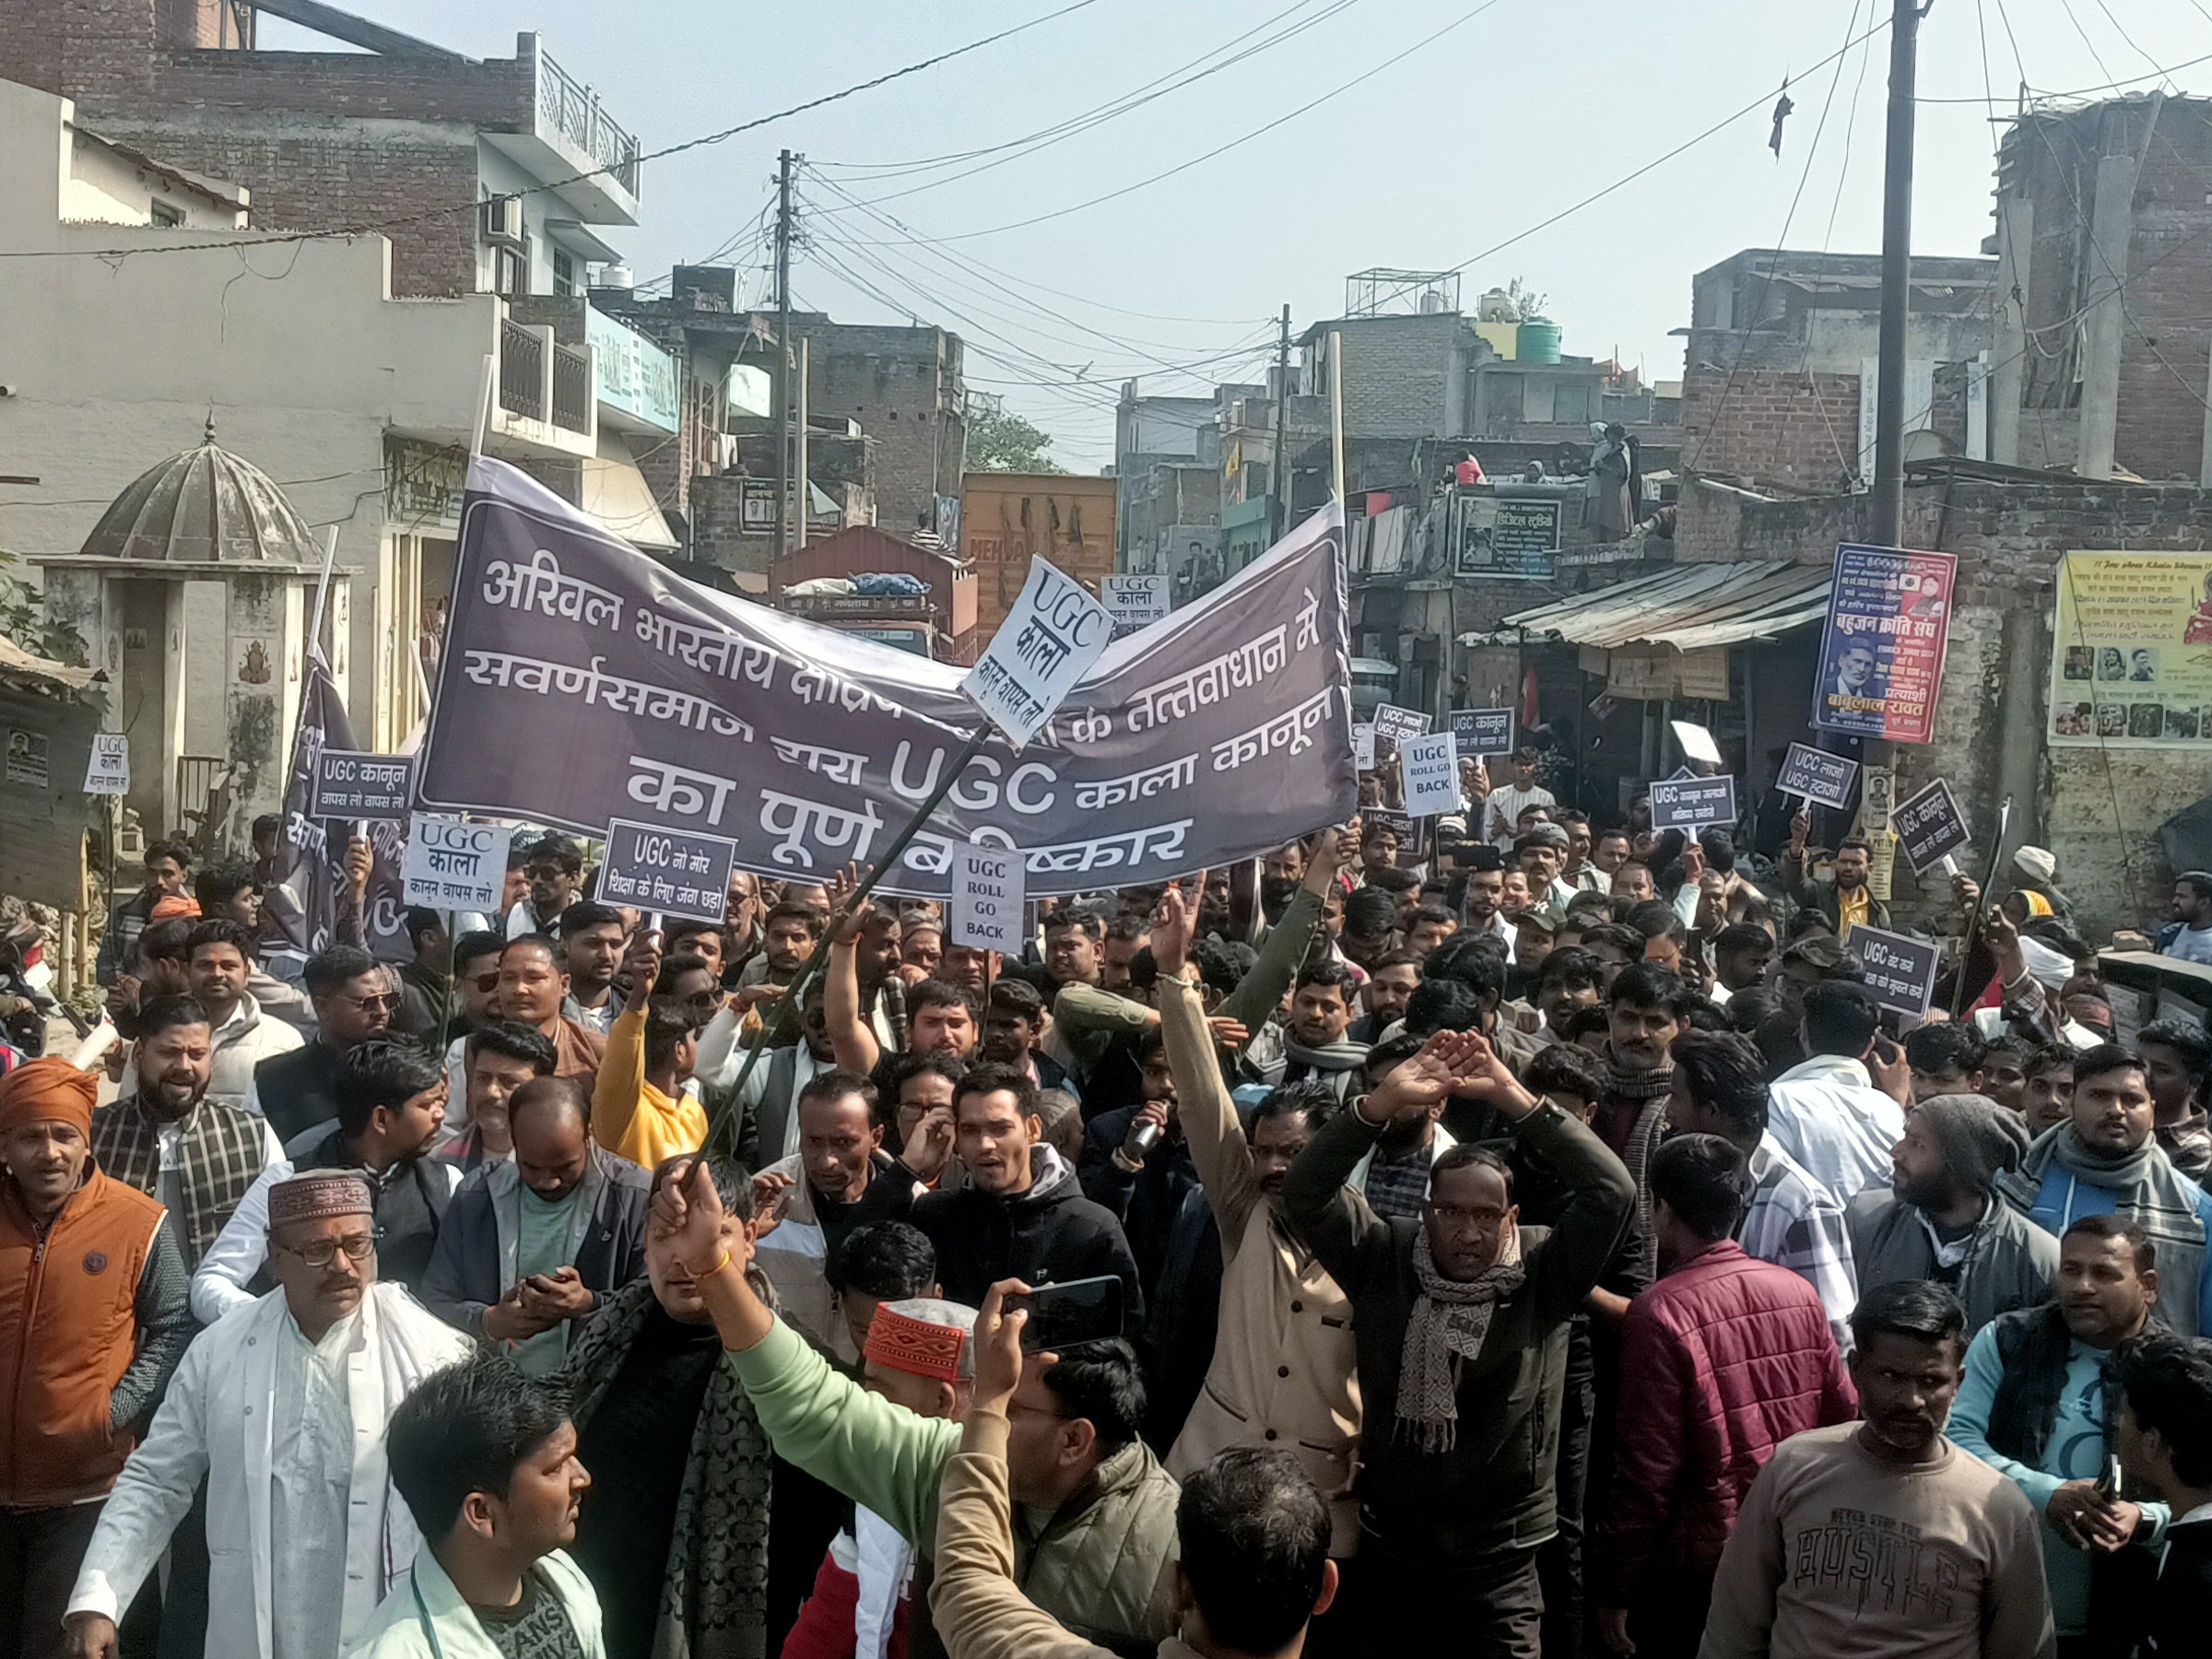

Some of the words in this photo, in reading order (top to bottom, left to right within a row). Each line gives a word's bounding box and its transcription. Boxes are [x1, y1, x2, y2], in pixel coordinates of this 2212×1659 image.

[1108, 577, 1159, 591] UGC
[1032, 567, 1103, 647] UGC
[1116, 592, 1153, 605] काला
[483, 549, 624, 630] अखिल
[635, 608, 780, 689] भारतीय
[1836, 613, 1878, 635] बहुजन
[1878, 615, 1912, 636] क्रांति
[1914, 618, 1936, 638] संघ
[1018, 615, 1071, 681] काला
[978, 654, 1008, 700] कानून
[1000, 676, 1031, 716] वापस
[1019, 695, 1051, 728] लो
[1884, 688, 1927, 702] प्रत्याशी
[1383, 708, 1403, 722] UCC
[1828, 693, 1887, 712] बाबूलाल
[1888, 700, 1924, 716] रावत
[1378, 722, 1395, 735] UGC
[1453, 715, 1473, 730] UGC
[1476, 715, 1507, 734] कानून
[98, 736, 125, 753] UGC
[890, 740, 1057, 814] UGC
[1075, 752, 1199, 809] काला
[1211, 684, 1334, 771] कानून
[1413, 745, 1446, 762] UGC
[100, 753, 122, 771] काला
[1410, 766, 1435, 776] ROLL
[1437, 763, 1451, 771] GO
[1795, 750, 1820, 771] UCC
[1819, 762, 1844, 779] लाओ
[324, 759, 357, 782] UGC
[360, 763, 407, 791] कानून
[1417, 779, 1449, 794] BACK
[1786, 771, 1808, 788] UGC
[1809, 778, 1841, 798] हटाओ
[322, 793, 347, 805] वापस
[349, 790, 362, 805] लो
[365, 794, 389, 808] वापस
[392, 793, 405, 809] लो
[1654, 786, 1677, 804] UGC
[628, 756, 737, 826] का
[759, 789, 884, 868] पूर्ण
[1897, 809, 1919, 836] UGC
[1916, 791, 1948, 821] कानून
[419, 821, 494, 853] UGC
[429, 848, 481, 877] काला
[634, 834, 672, 867] UGC
[673, 846, 688, 870] नो
[689, 849, 712, 875] मोर
[968, 858, 1006, 878] UGC
[410, 878, 440, 902] कानून
[443, 883, 473, 902] वापस
[477, 881, 493, 903] लो
[607, 868, 636, 896] शिक्षा
[637, 874, 652, 897] के
[653, 876, 675, 903] लिए
[677, 881, 700, 905] जंग
[968, 881, 1005, 898] ROLL
[975, 901, 996, 916] GO
[967, 922, 1004, 939] BACK
[1864, 940, 1888, 965] UGC
